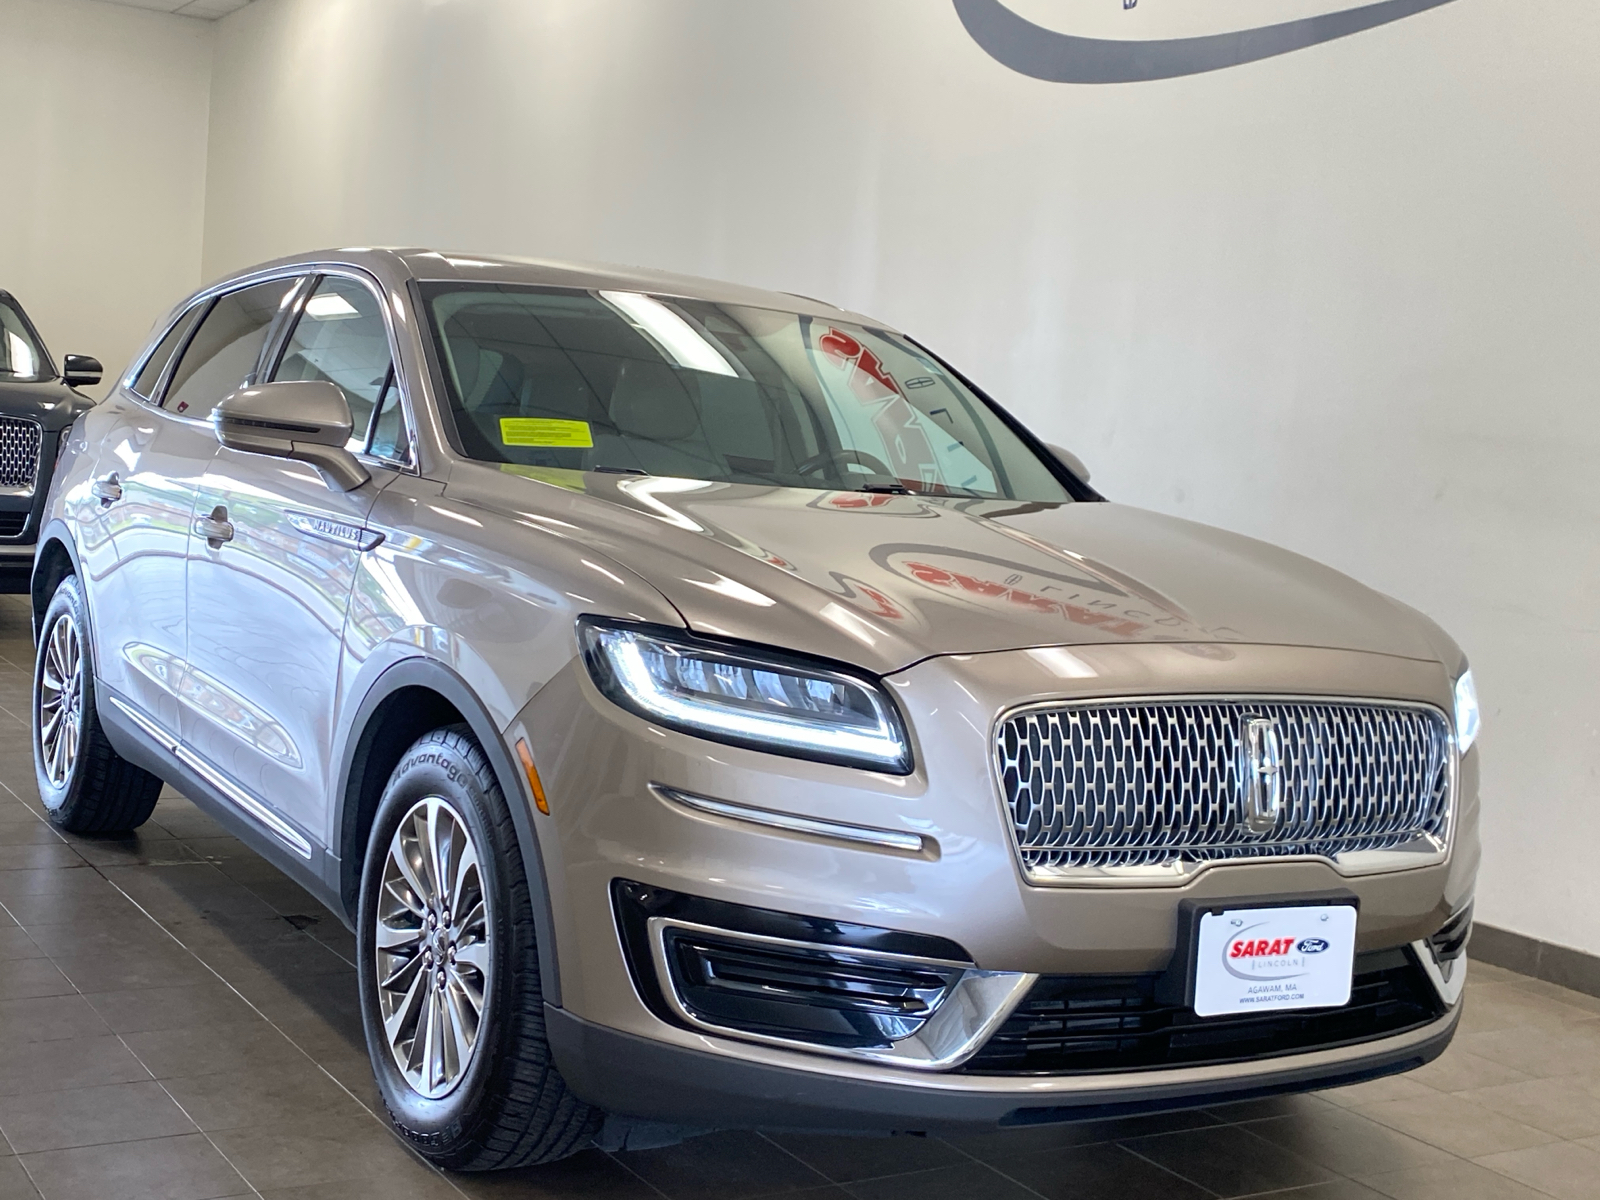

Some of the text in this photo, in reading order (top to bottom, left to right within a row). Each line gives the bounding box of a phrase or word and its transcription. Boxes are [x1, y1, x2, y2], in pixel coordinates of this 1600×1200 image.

[313, 518, 357, 540] NAUTILUS
[1229, 937, 1326, 959] SARAT Ford
[1257, 959, 1299, 969] LINCOLN
[1247, 983, 1298, 995] AGAWAM, MA
[1239, 993, 1305, 1004] WWW.SARATFORD.COM
